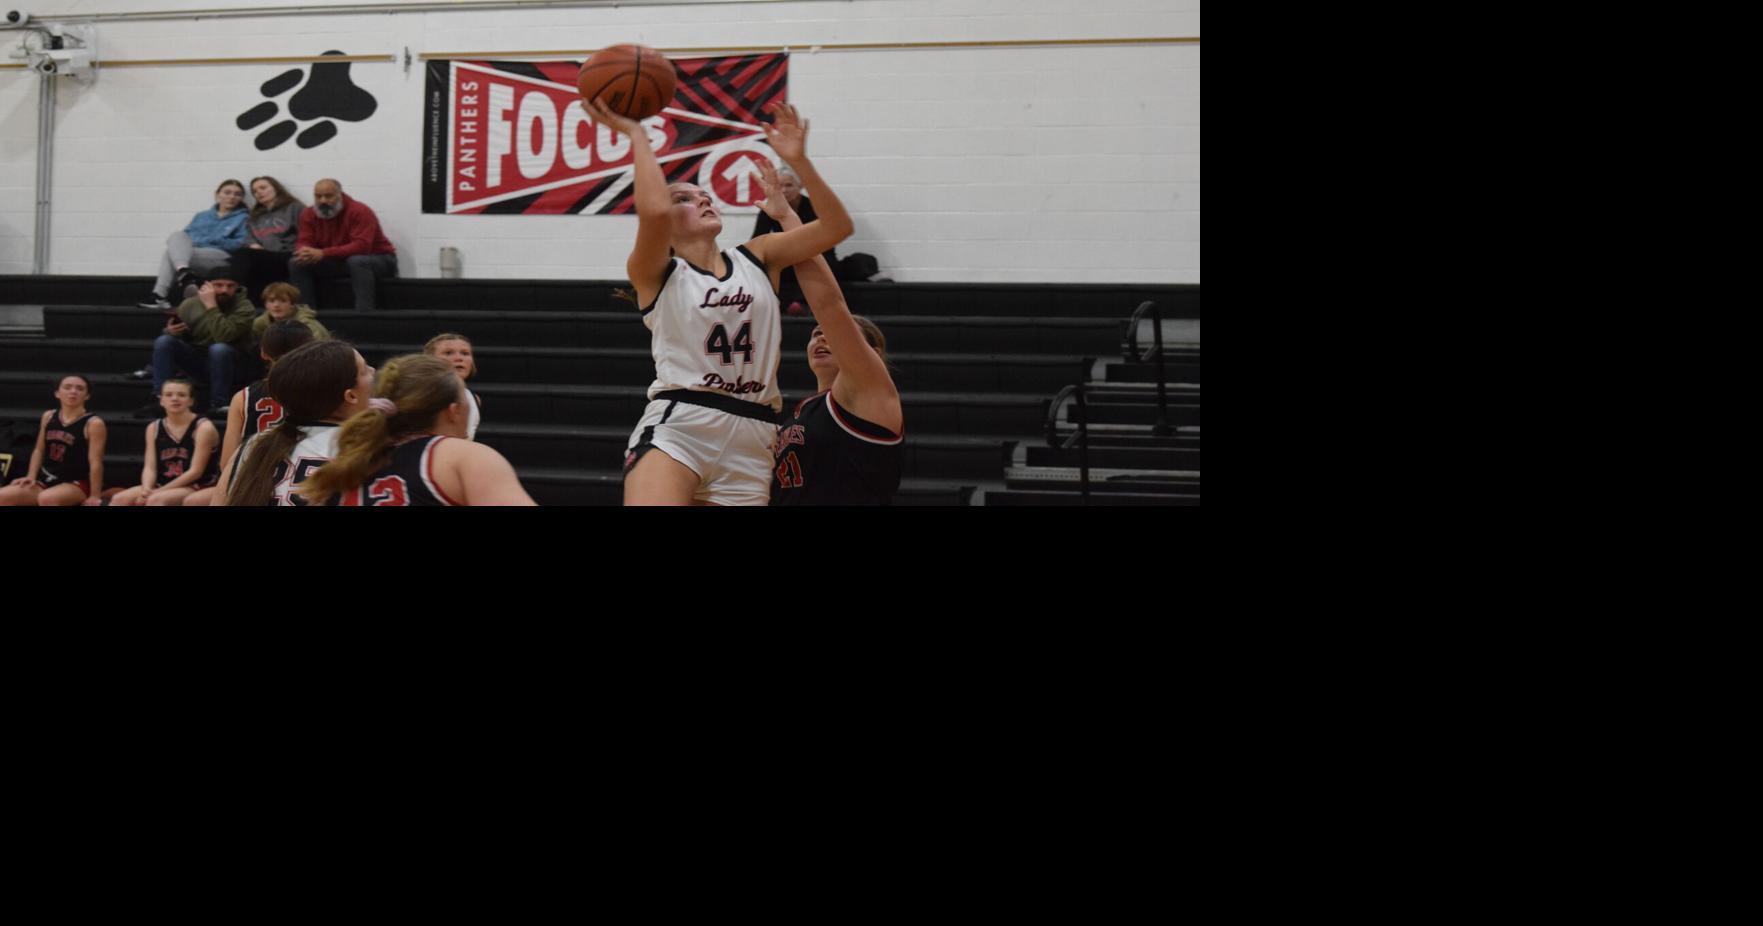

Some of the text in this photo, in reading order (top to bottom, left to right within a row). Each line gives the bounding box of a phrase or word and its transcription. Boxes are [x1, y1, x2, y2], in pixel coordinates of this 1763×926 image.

[458, 81, 479, 191] PANTHERS
[486, 83, 668, 189] FOCUS
[700, 286, 754, 313] Lady
[704, 320, 755, 367] 44
[776, 450, 805, 489] 21
